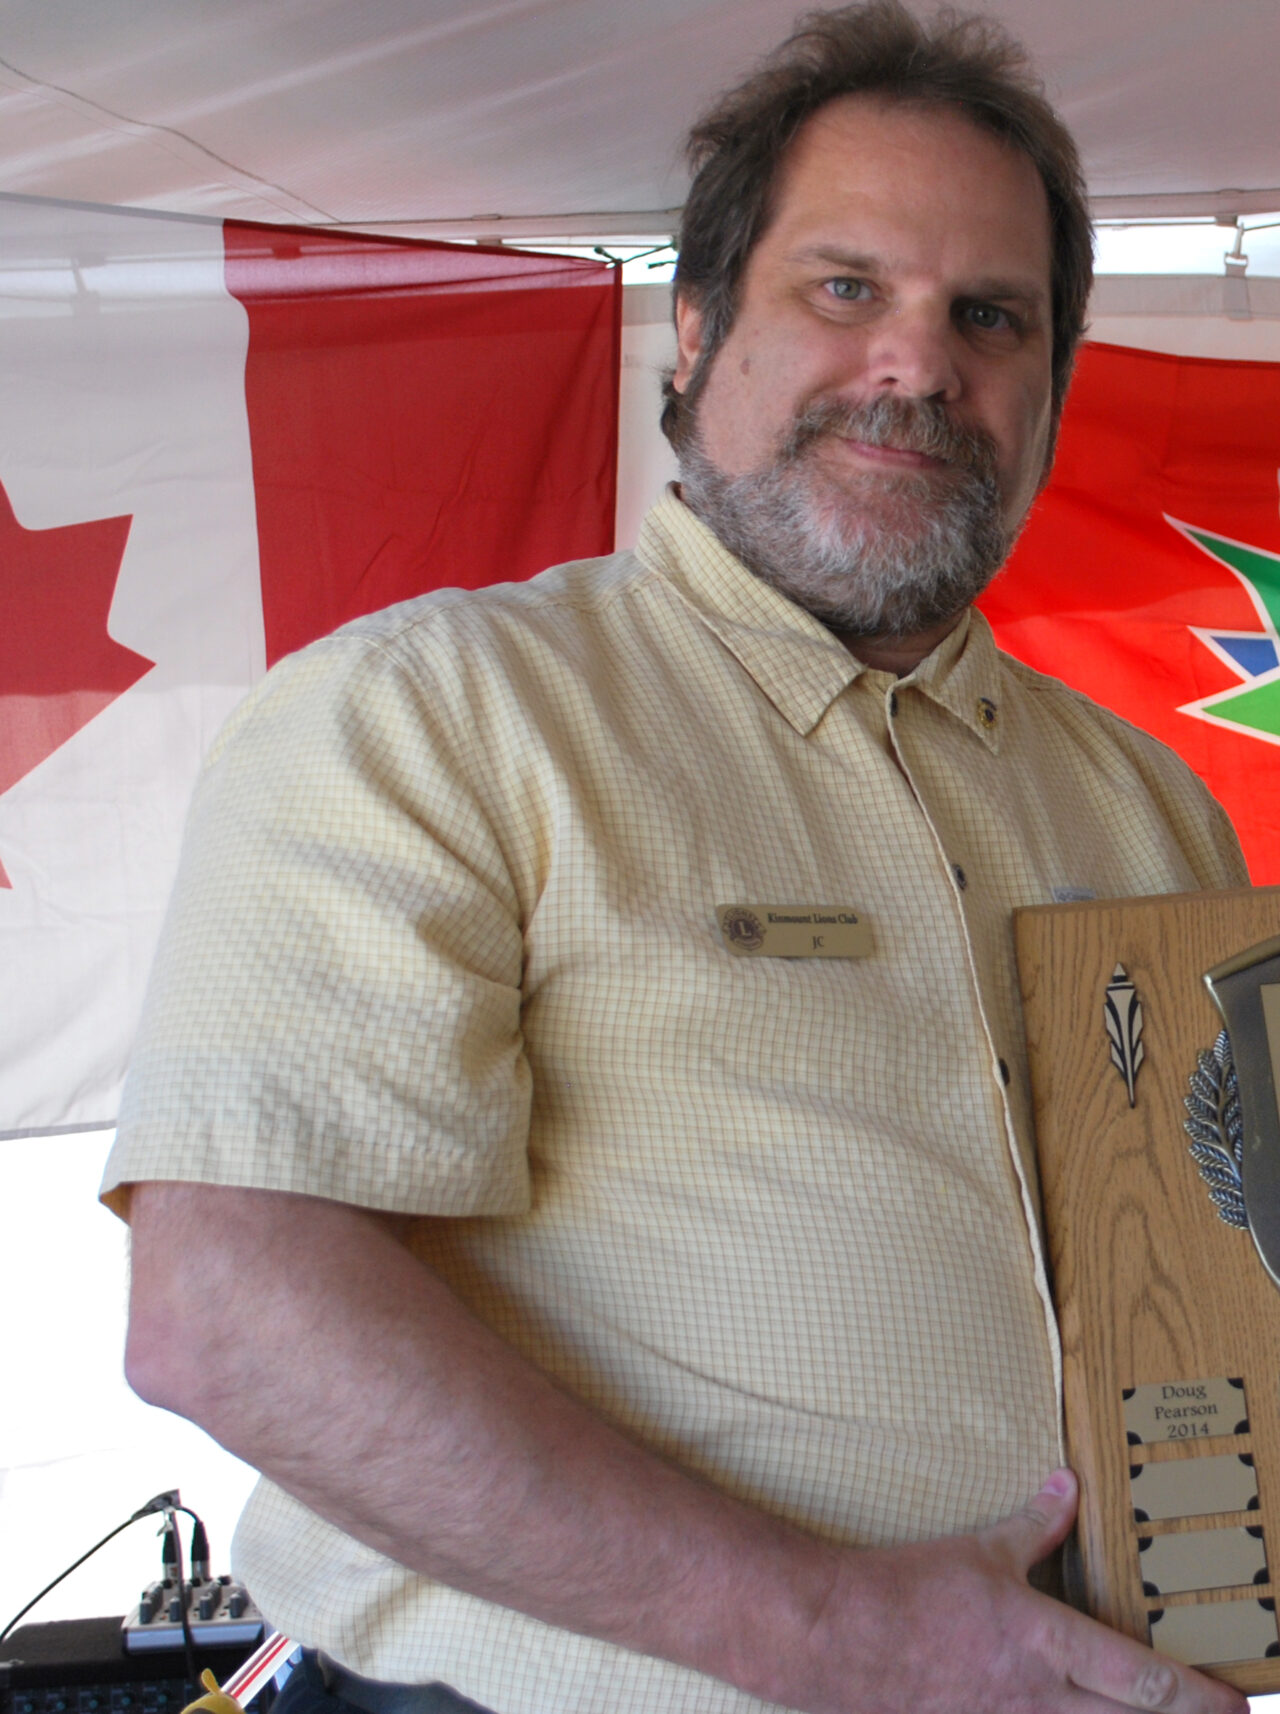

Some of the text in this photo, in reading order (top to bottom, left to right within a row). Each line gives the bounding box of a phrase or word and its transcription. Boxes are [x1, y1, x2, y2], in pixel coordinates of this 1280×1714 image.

[813, 912, 837, 924] Lions
[838, 912, 859, 925] Club
[812, 935, 825, 950] JC
[1162, 1385, 1207, 1400] Doug
[1154, 1403, 1218, 1420] Pearson
[1167, 1422, 1209, 1438] 2014
